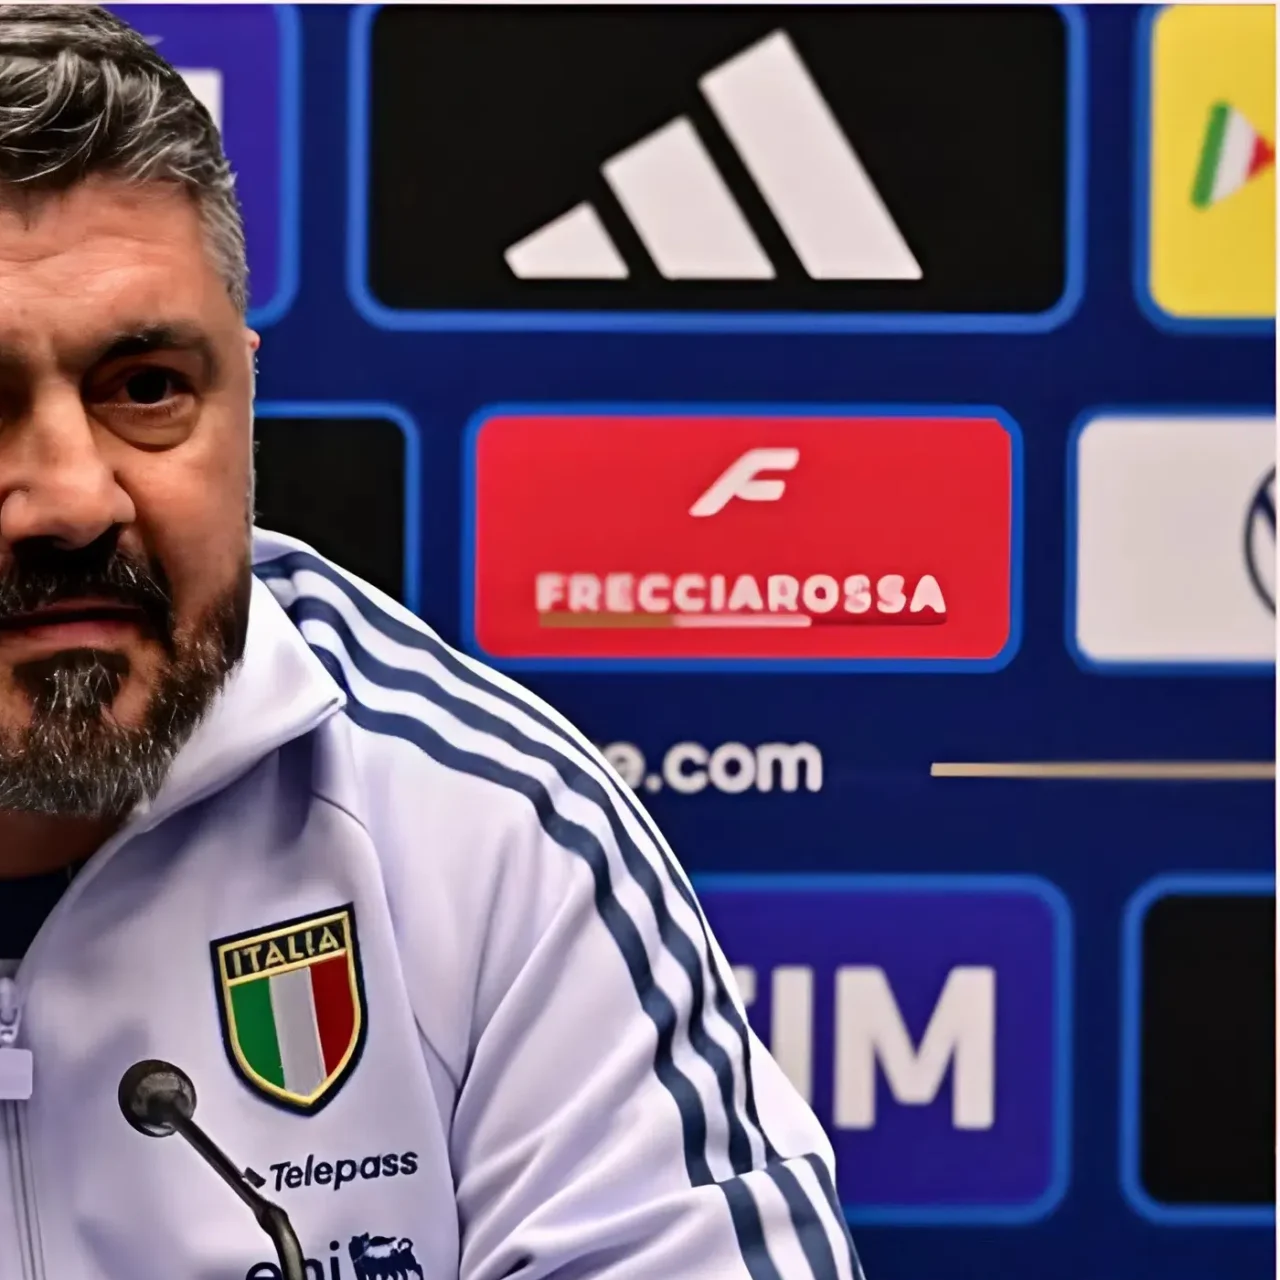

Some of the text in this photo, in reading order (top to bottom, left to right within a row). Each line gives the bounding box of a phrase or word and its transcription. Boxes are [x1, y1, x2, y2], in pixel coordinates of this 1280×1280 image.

[534, 571, 947, 614] FRECCIAROSSA
[230, 924, 342, 978] ITALIA
[730, 964, 997, 1131] IM
[269, 1150, 420, 1193] Telepass
